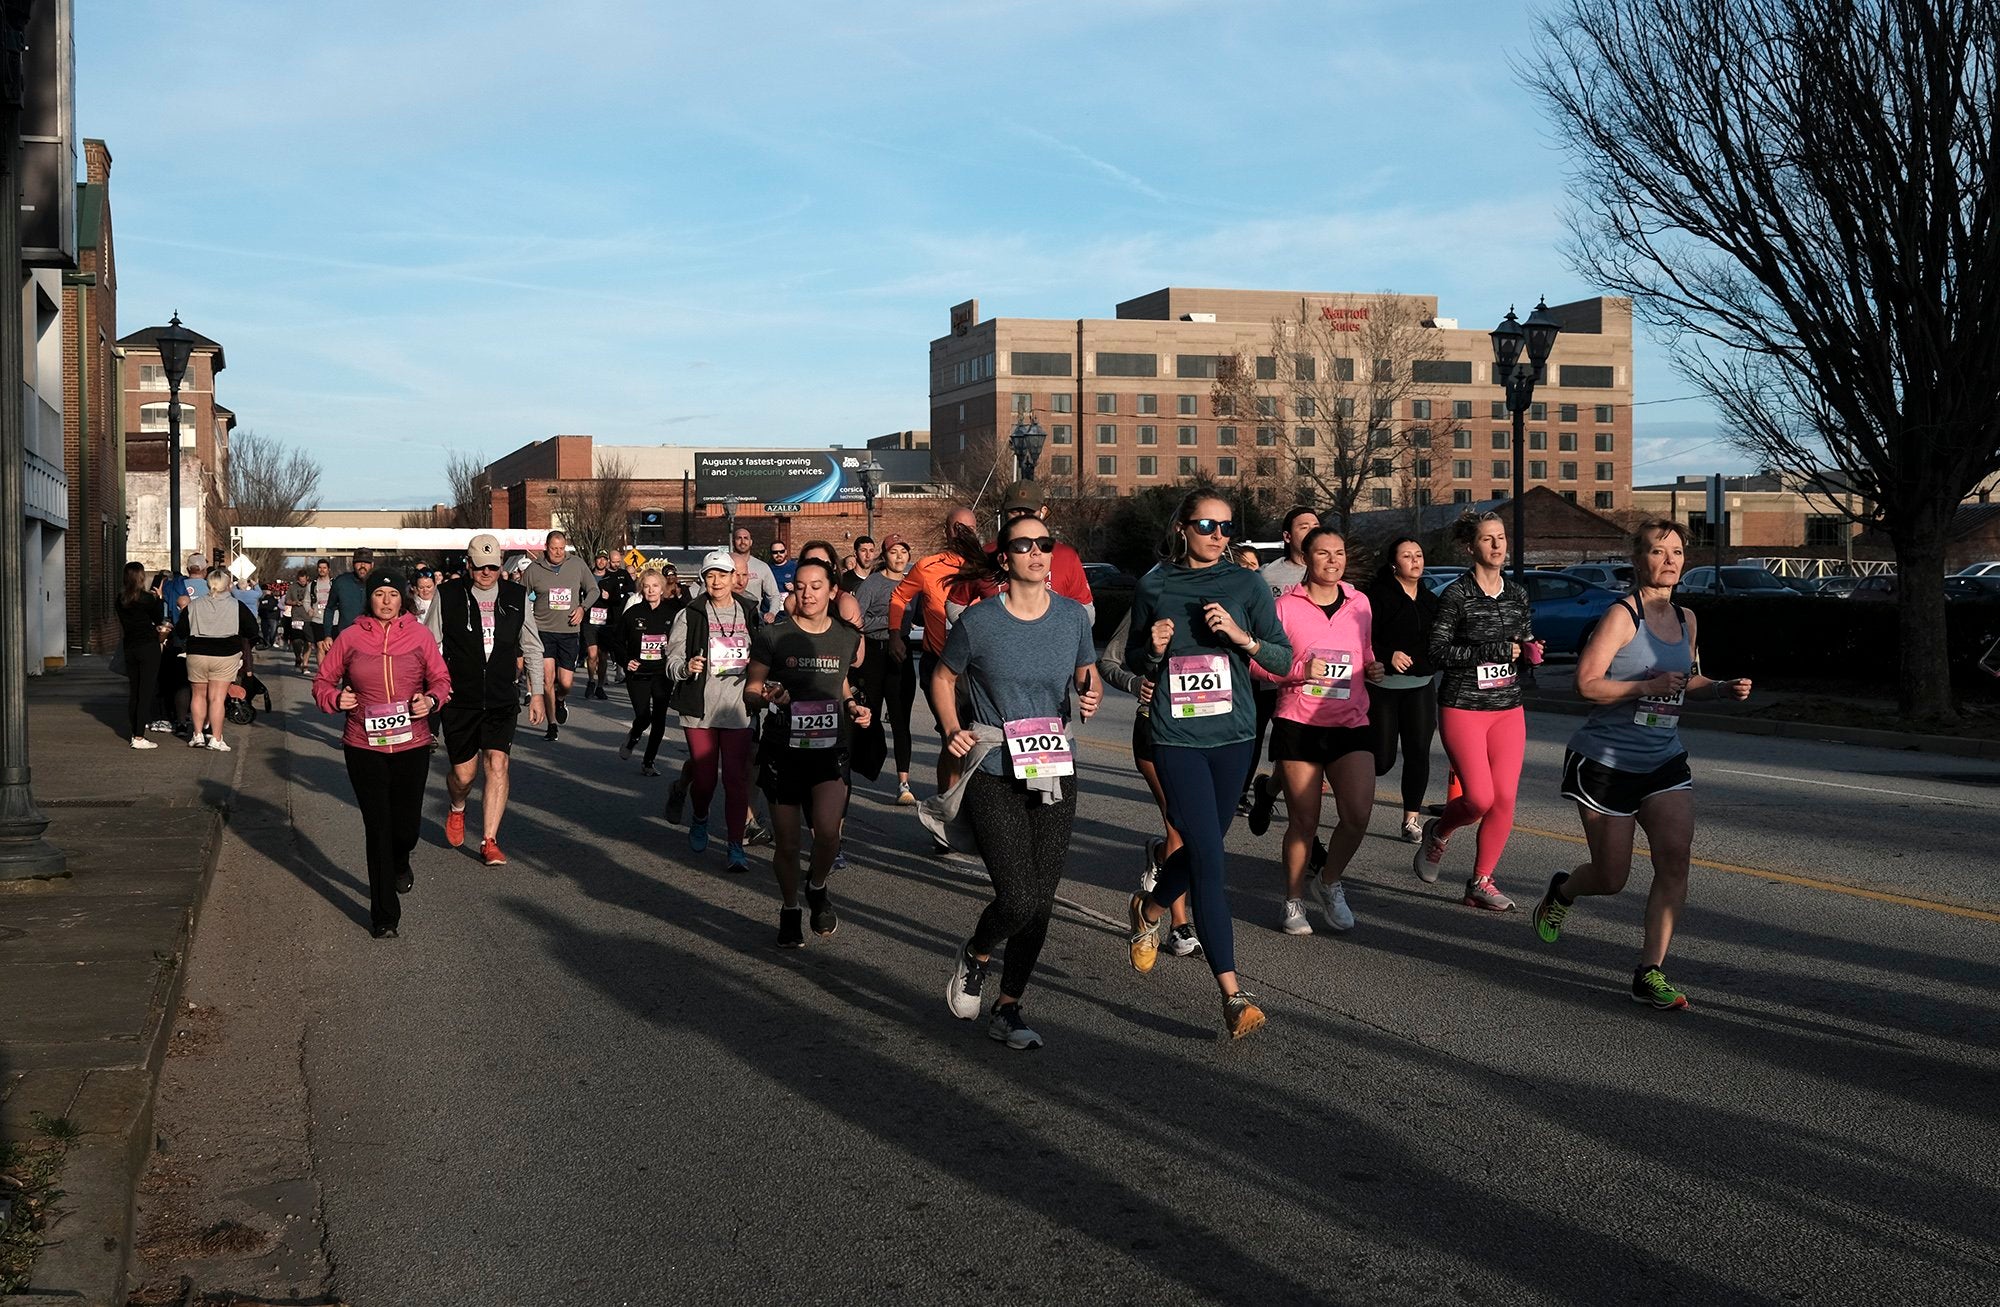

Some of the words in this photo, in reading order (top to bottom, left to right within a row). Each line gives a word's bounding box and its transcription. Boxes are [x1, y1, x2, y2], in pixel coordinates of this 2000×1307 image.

[702, 458, 744, 467] Augusta's
[746, 457, 811, 467] fastest-growing
[711, 468, 727, 476] and
[729, 468, 785, 477] cybersecurity
[788, 467, 825, 476] services.
[799, 657, 840, 668] SPARTAN
[1178, 674, 1221, 692] 1261
[371, 715, 406, 730] 1399
[798, 715, 834, 729] 1243
[1016, 735, 1064, 752] 1202
